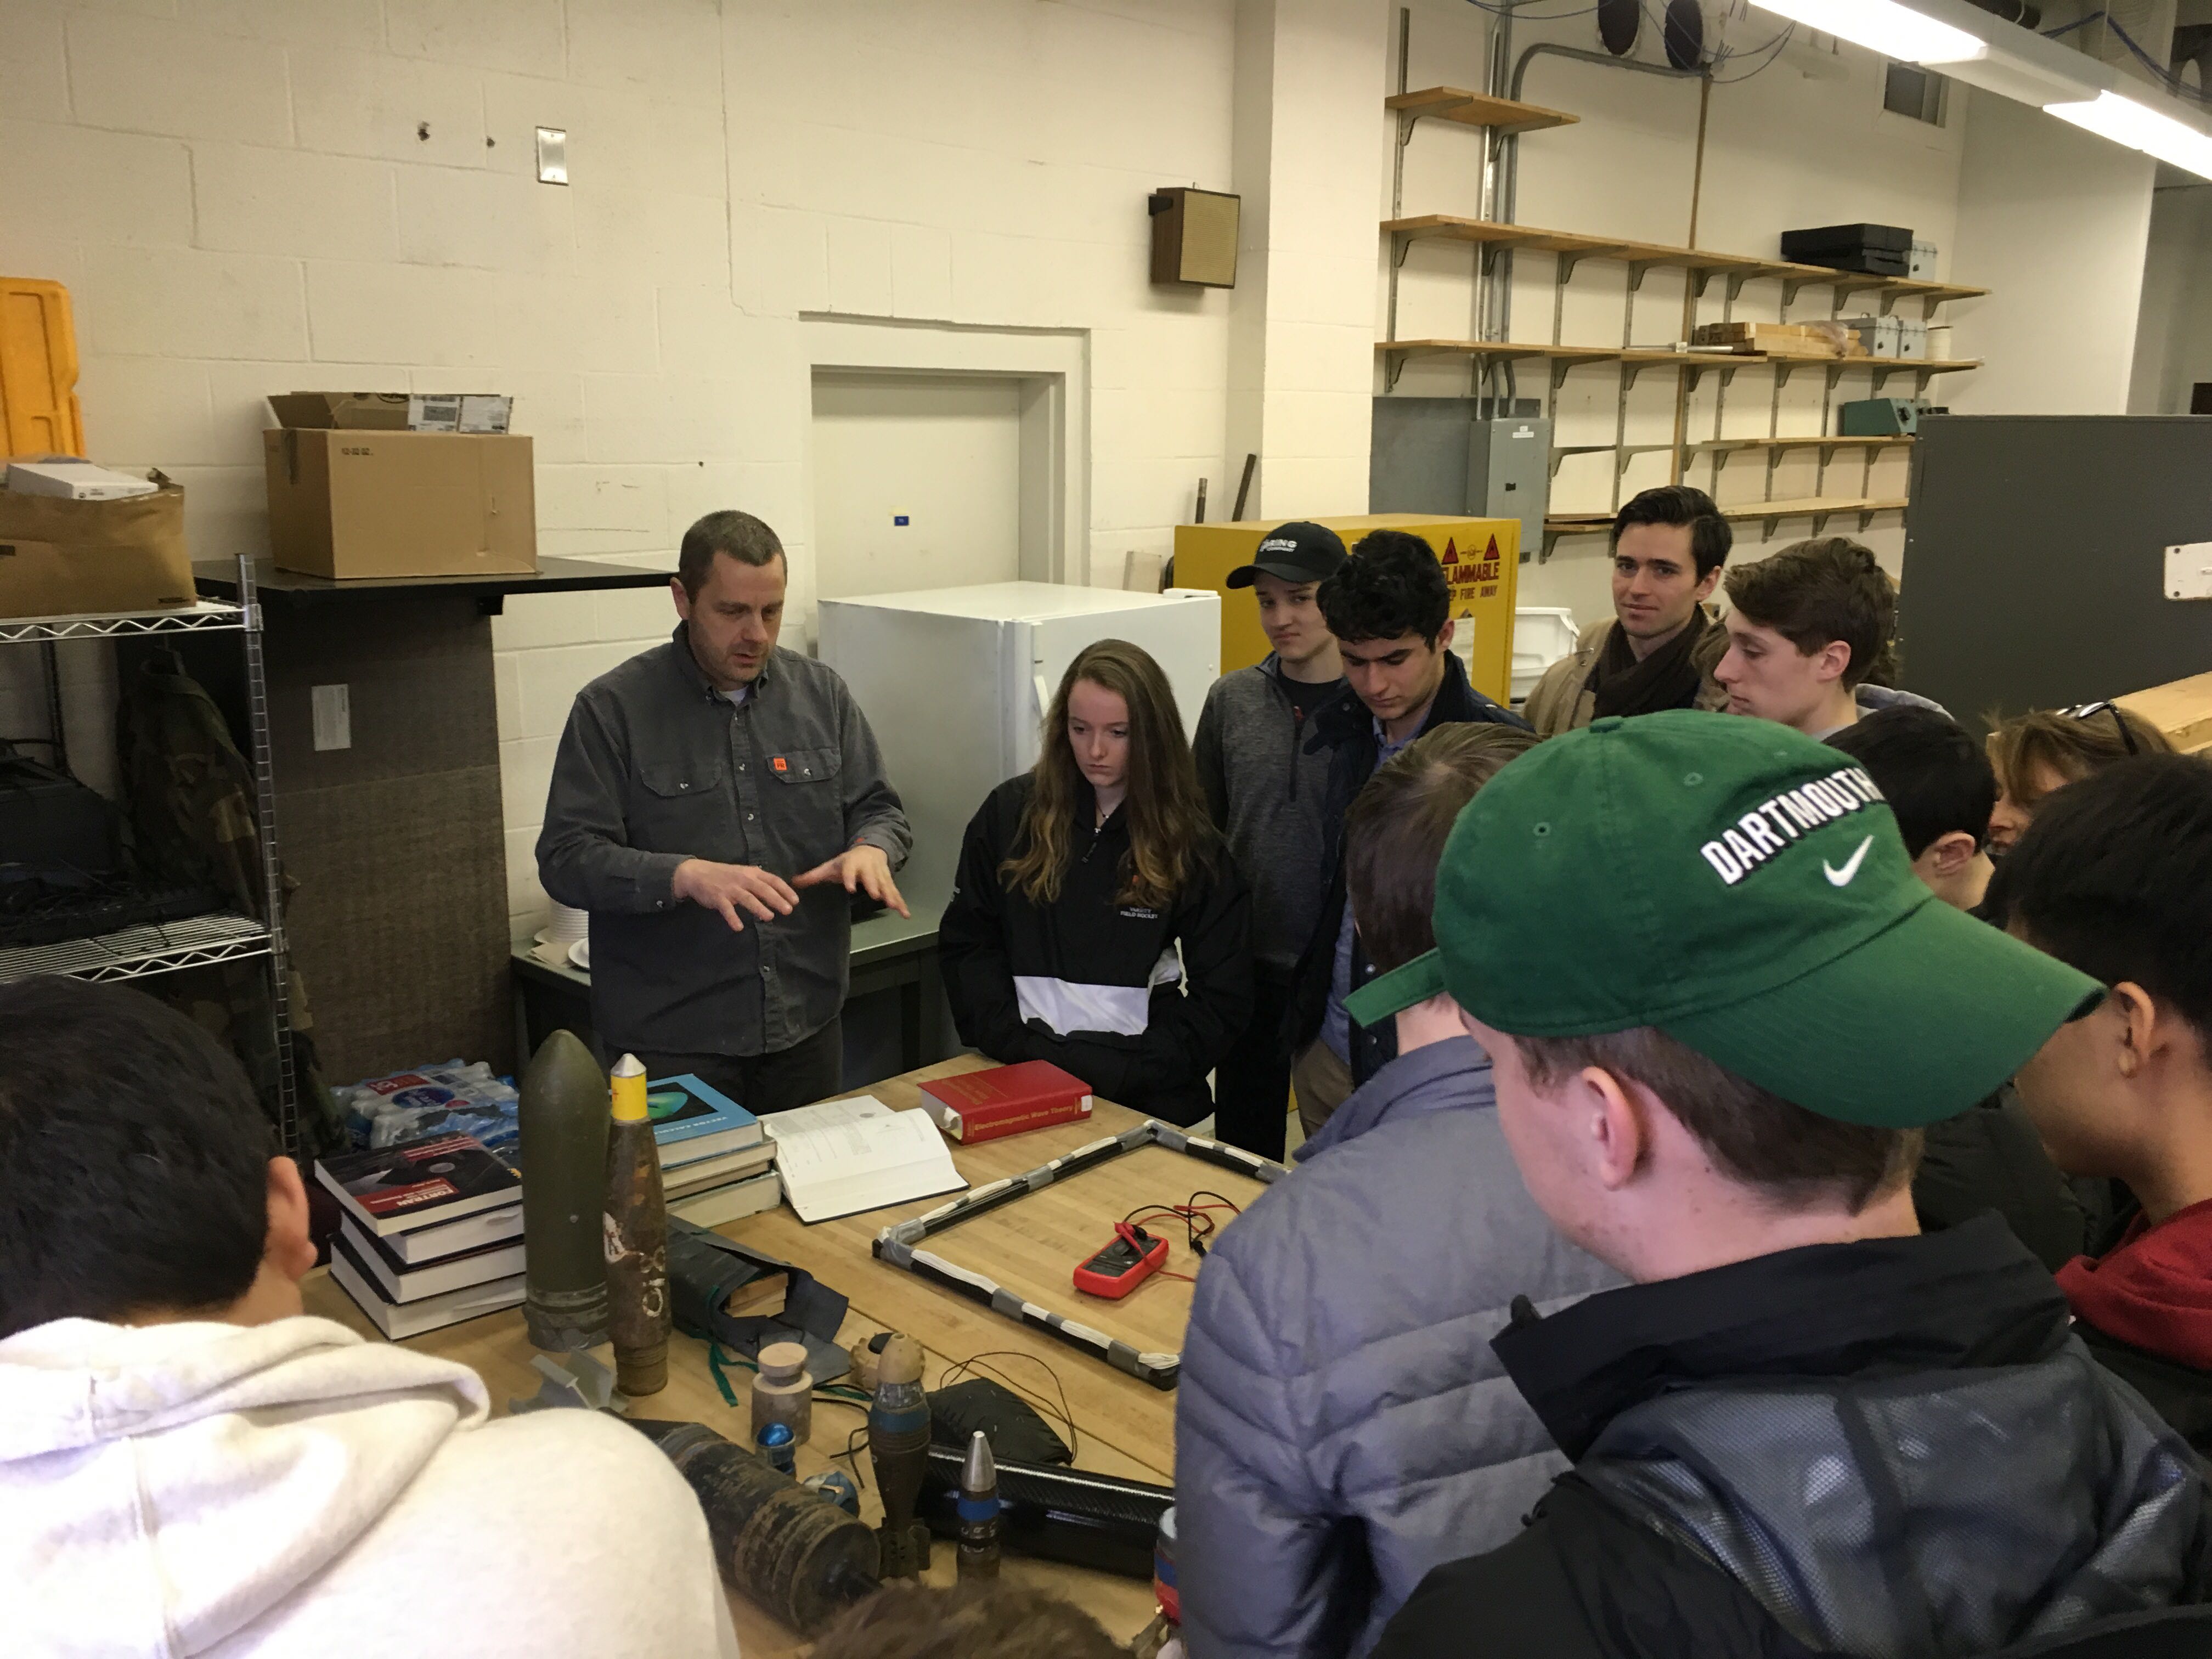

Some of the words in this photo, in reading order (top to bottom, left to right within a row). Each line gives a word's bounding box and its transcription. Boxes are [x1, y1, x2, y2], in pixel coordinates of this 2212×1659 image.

[1460, 587, 1475, 600] FIRE
[1480, 585, 1498, 598] AWAY
[1700, 767, 1886, 885] DARTMOUTH
[693, 1116, 727, 1126] VECTOR
[396, 1187, 454, 1206] FORTRAN
